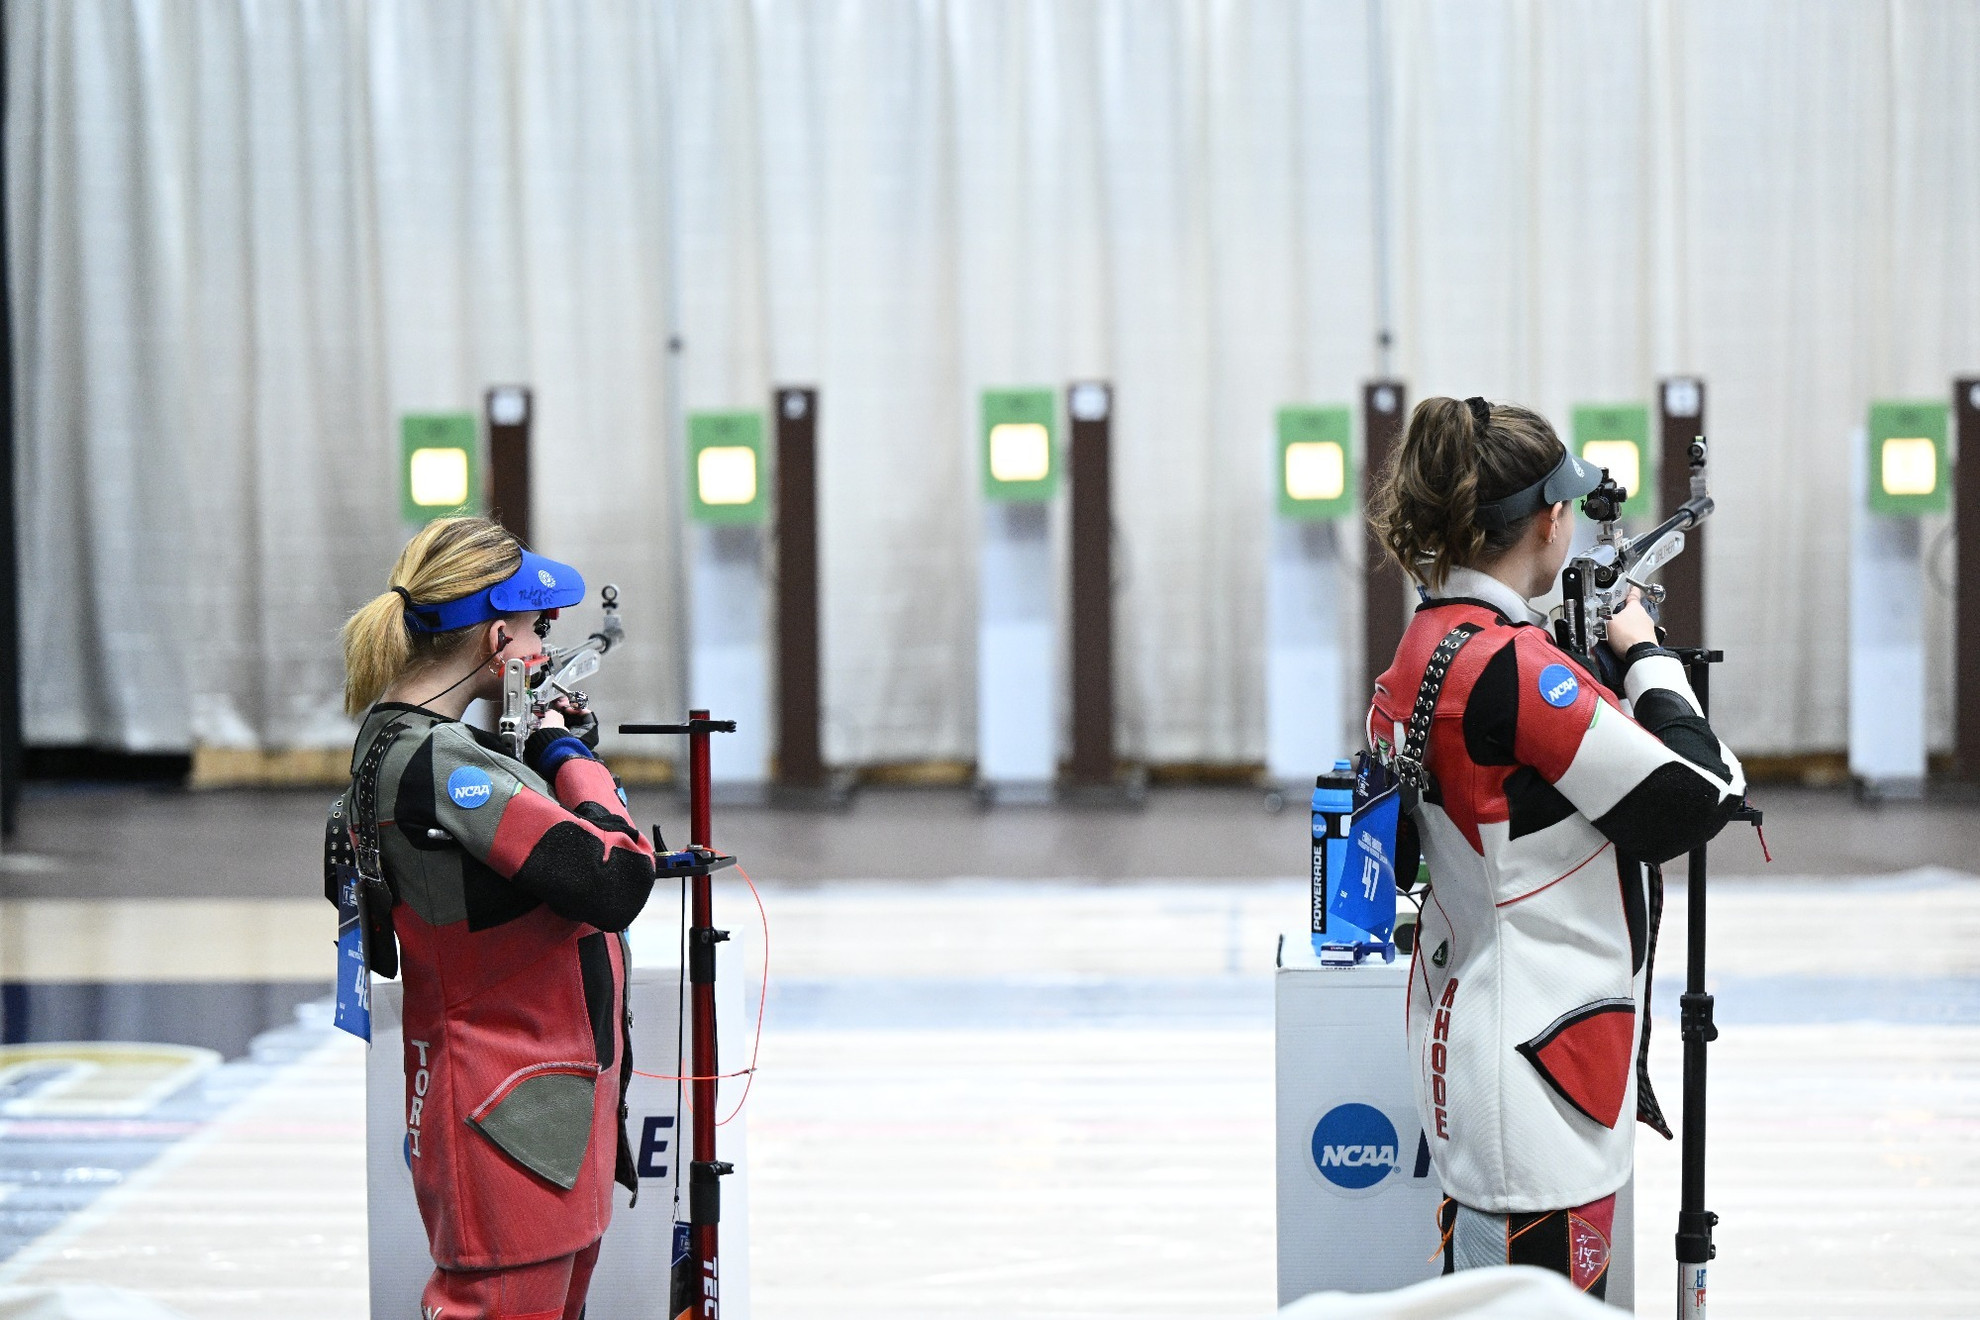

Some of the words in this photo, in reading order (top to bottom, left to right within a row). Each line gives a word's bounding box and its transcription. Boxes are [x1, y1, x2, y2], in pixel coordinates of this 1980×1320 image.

[1547, 676, 1578, 702] NCAA
[454, 784, 490, 799] NCAA
[1313, 845, 1322, 931] POWERADE
[1361, 855, 1380, 902] 47
[1431, 977, 1459, 1141] RHODE
[409, 1039, 430, 1158] TORI
[1320, 1144, 1396, 1168] NCAA
